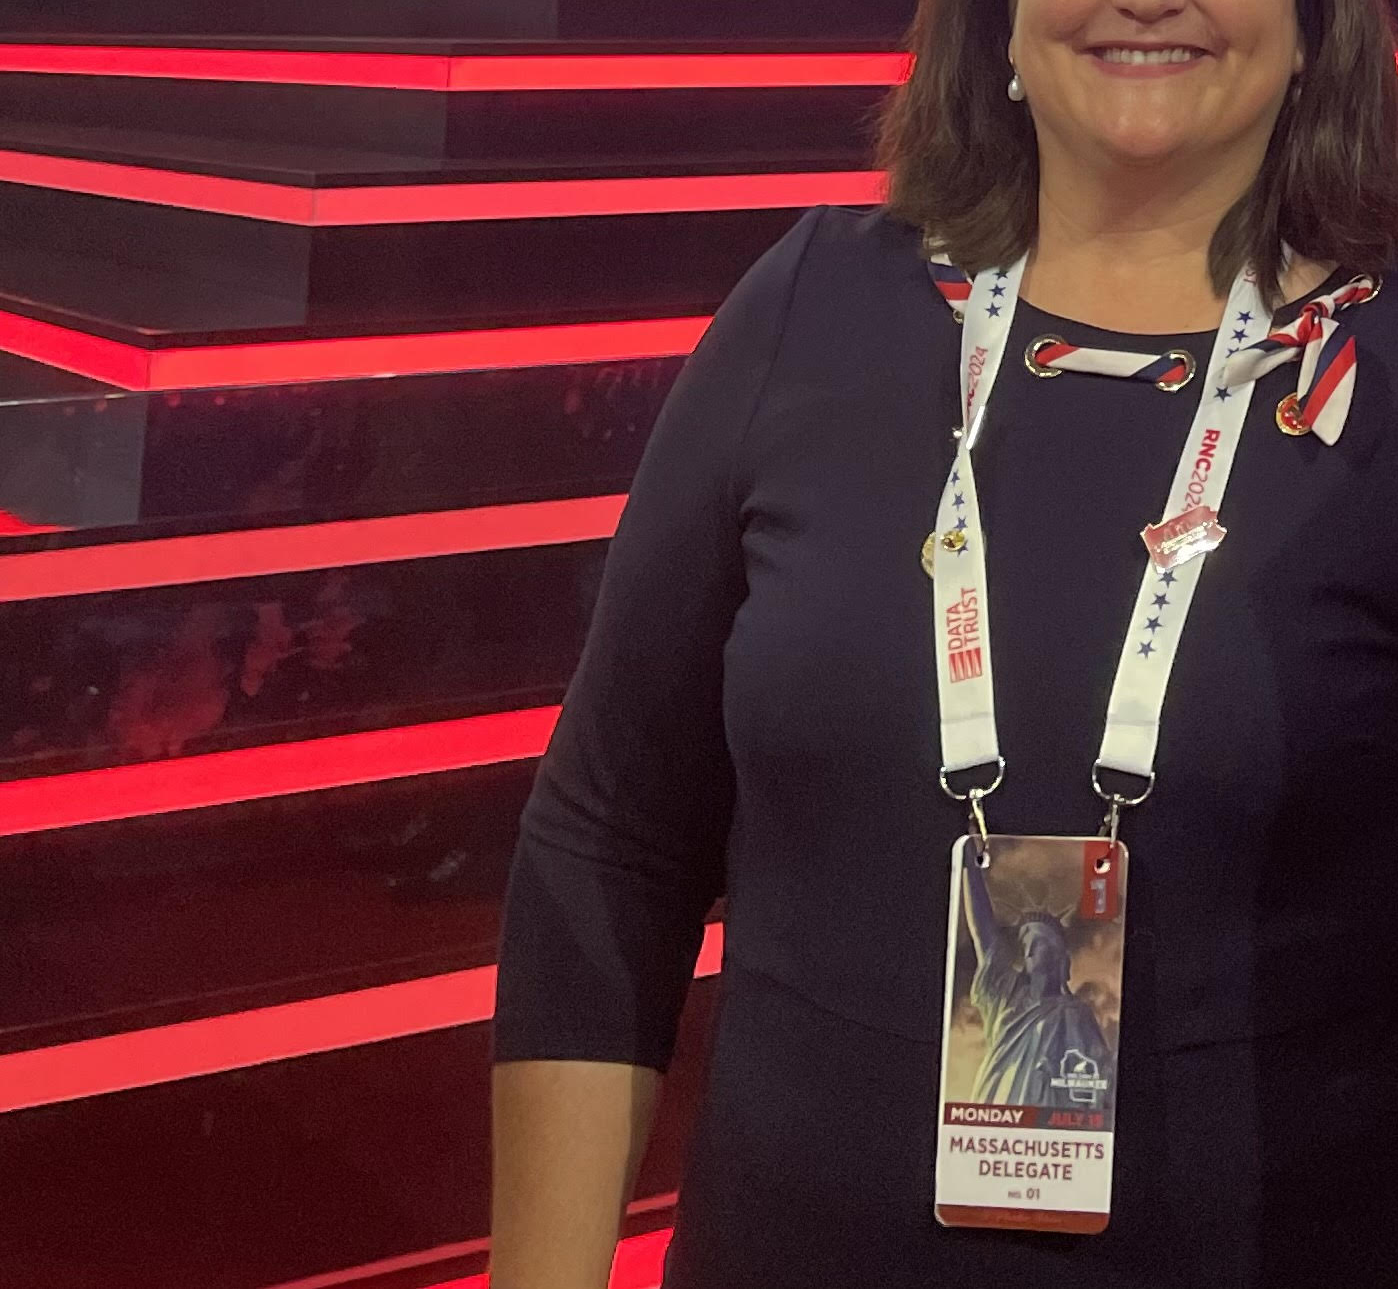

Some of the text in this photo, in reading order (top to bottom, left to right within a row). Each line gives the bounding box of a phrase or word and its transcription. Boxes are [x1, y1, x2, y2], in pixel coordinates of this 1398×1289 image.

[946, 601, 963, 651] DATA
[961, 587, 980, 647] TRUST
[950, 1106, 1024, 1124] MONDAY
[950, 1135, 1105, 1160] MASSACHUSETTS
[978, 1159, 1073, 1181] DELEGATE
